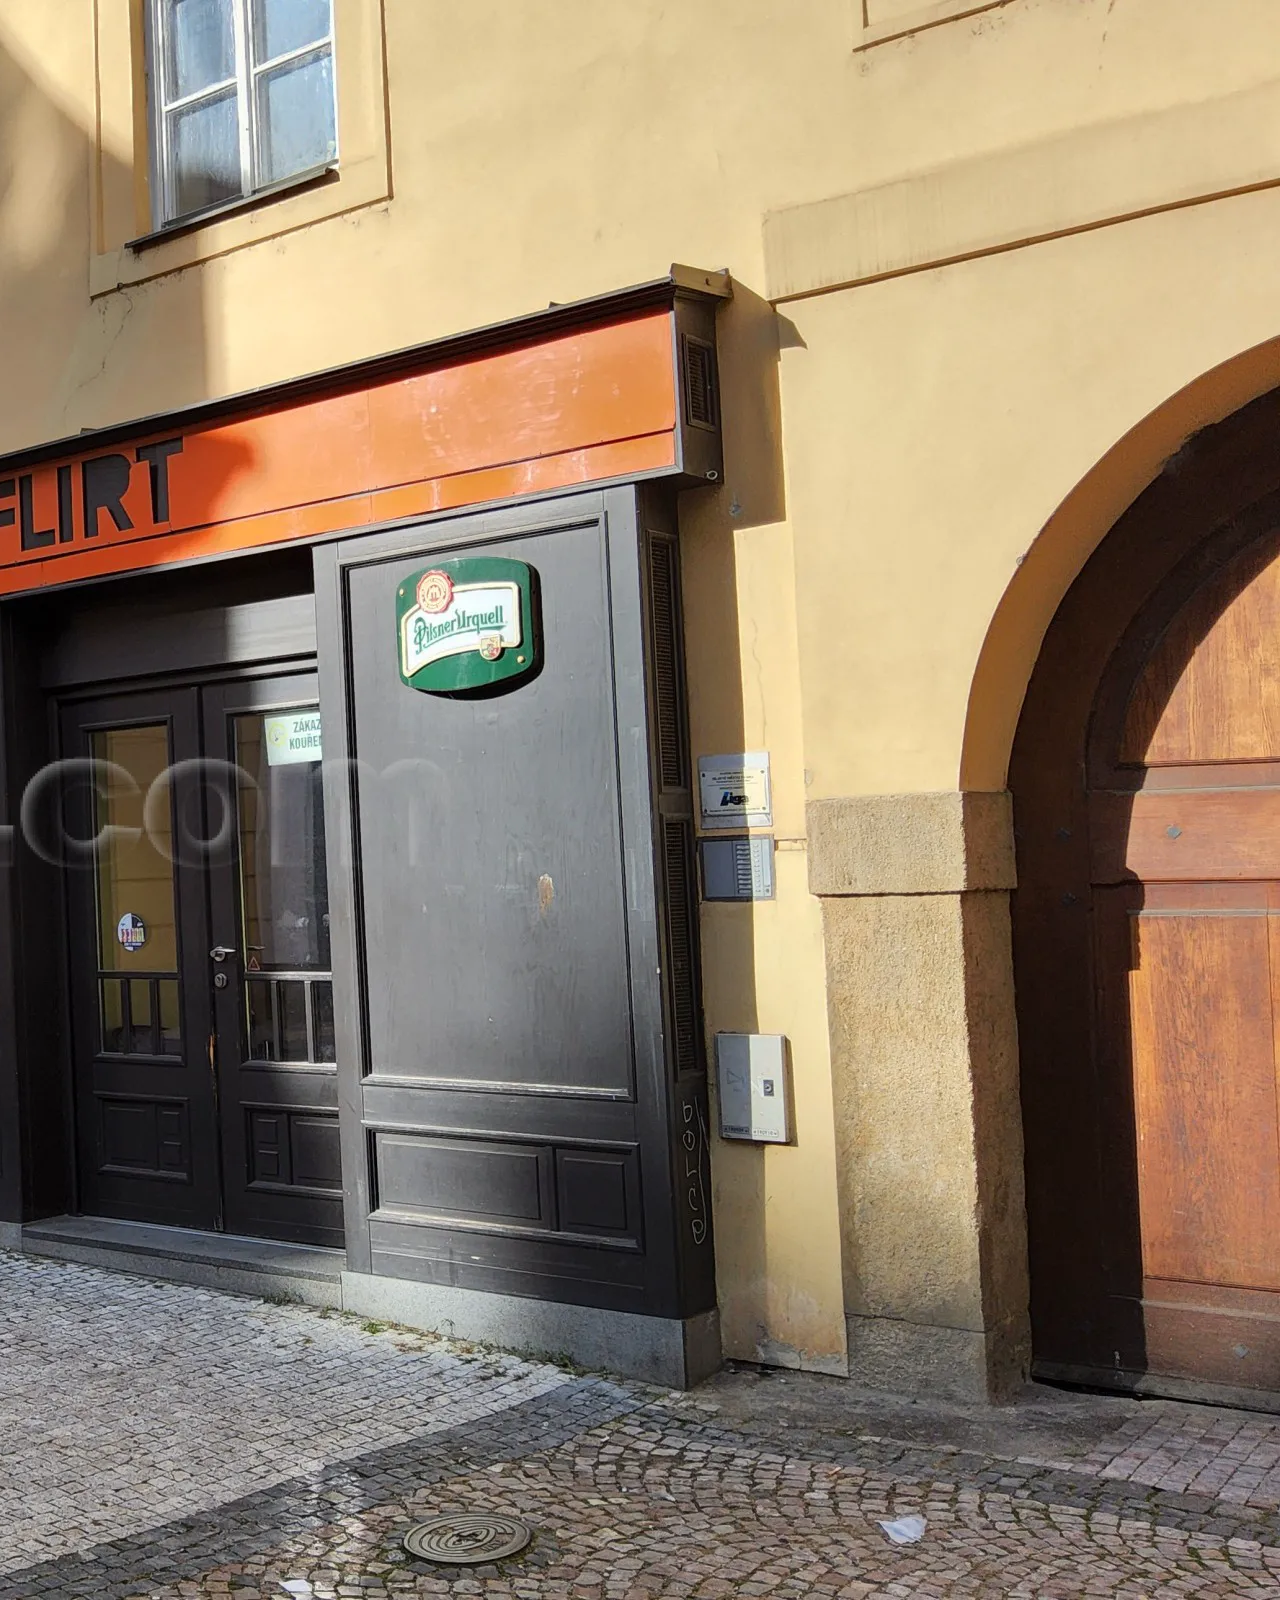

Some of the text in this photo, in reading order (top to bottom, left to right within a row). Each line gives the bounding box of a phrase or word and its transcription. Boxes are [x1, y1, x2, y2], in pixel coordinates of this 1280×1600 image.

[413, 605, 504, 655] Pilsner Urquell
[293, 719, 321, 733] ZÁKAZ
